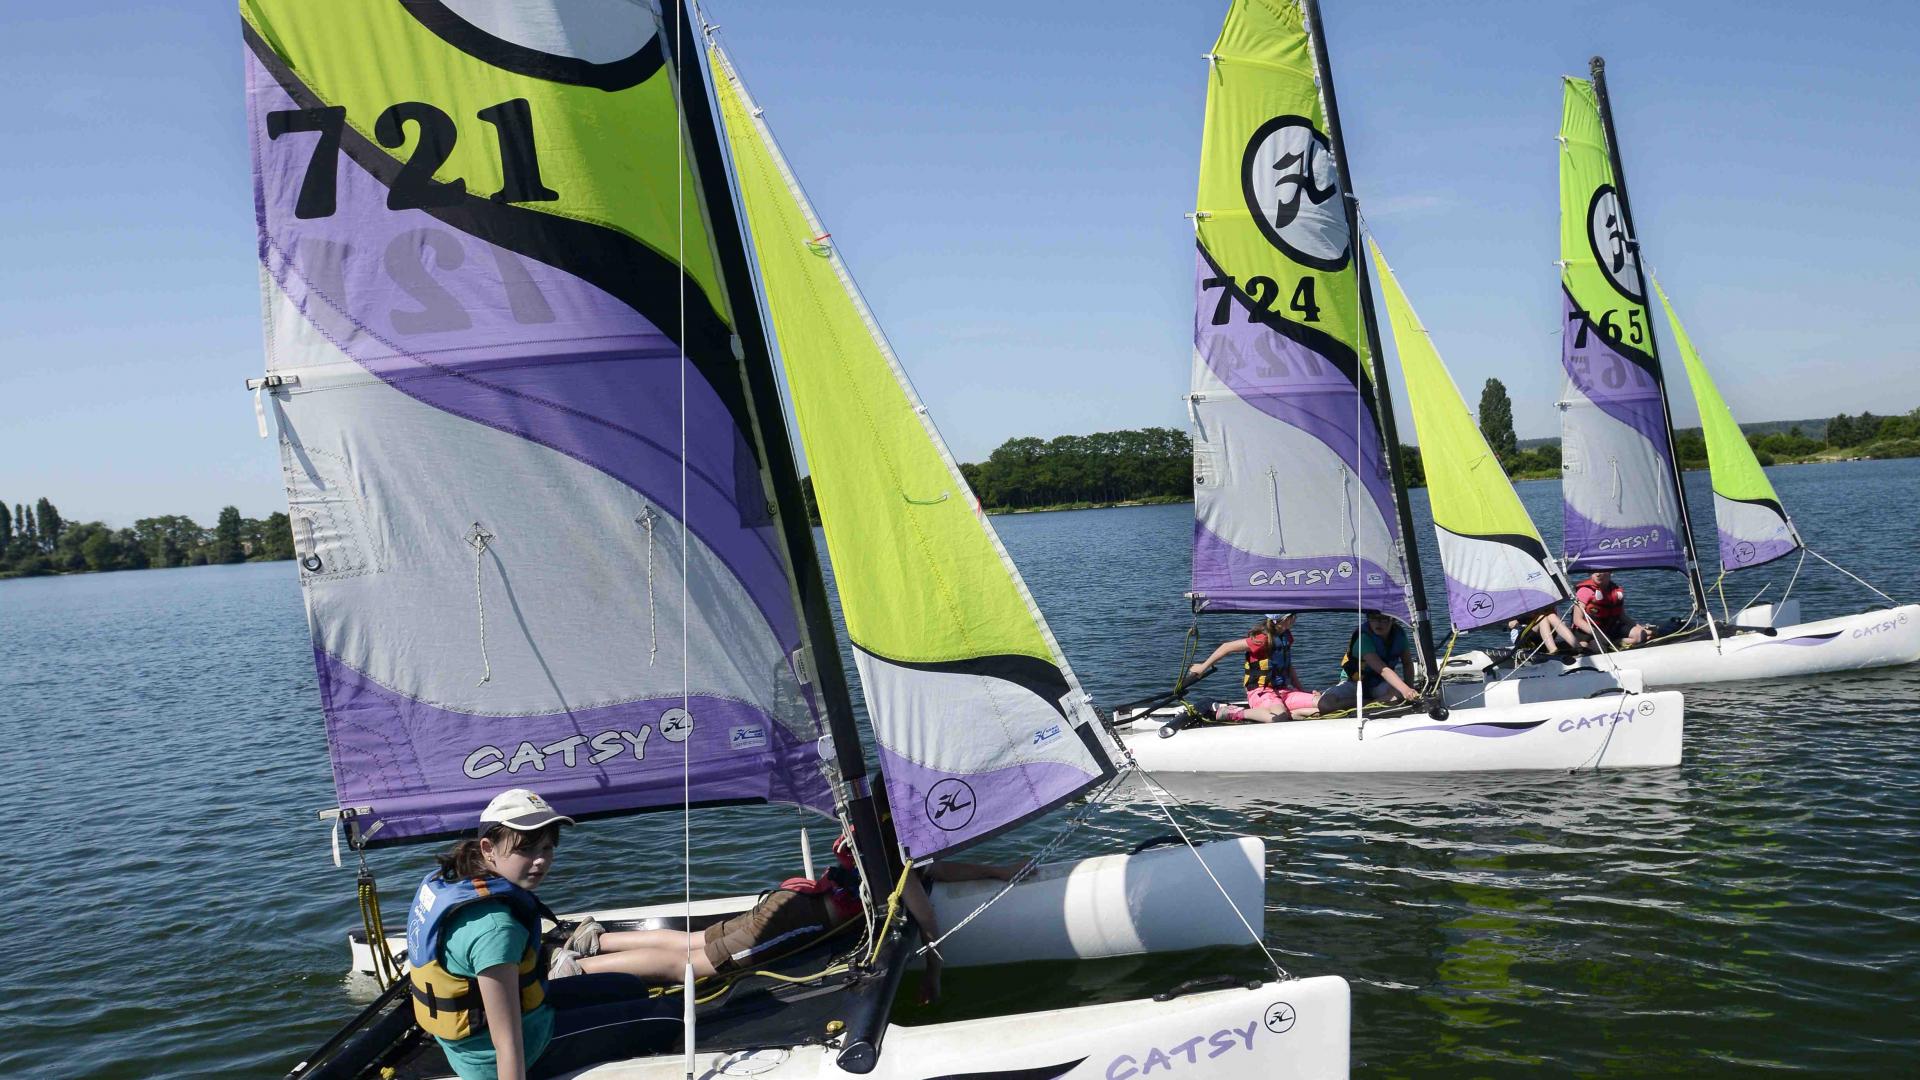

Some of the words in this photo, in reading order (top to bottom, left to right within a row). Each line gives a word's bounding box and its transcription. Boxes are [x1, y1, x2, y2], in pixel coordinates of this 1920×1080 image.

[267, 98, 559, 219] 721
[1203, 275, 1321, 325] 724
[1568, 309, 1644, 349] 765
[1599, 535, 1650, 550] CATSY
[1249, 567, 1336, 586] CATSY
[1853, 620, 1897, 639] CATSY
[1558, 709, 1635, 732] CATSY
[463, 724, 652, 779] CATSY
[1105, 1021, 1258, 1080] CATSY
